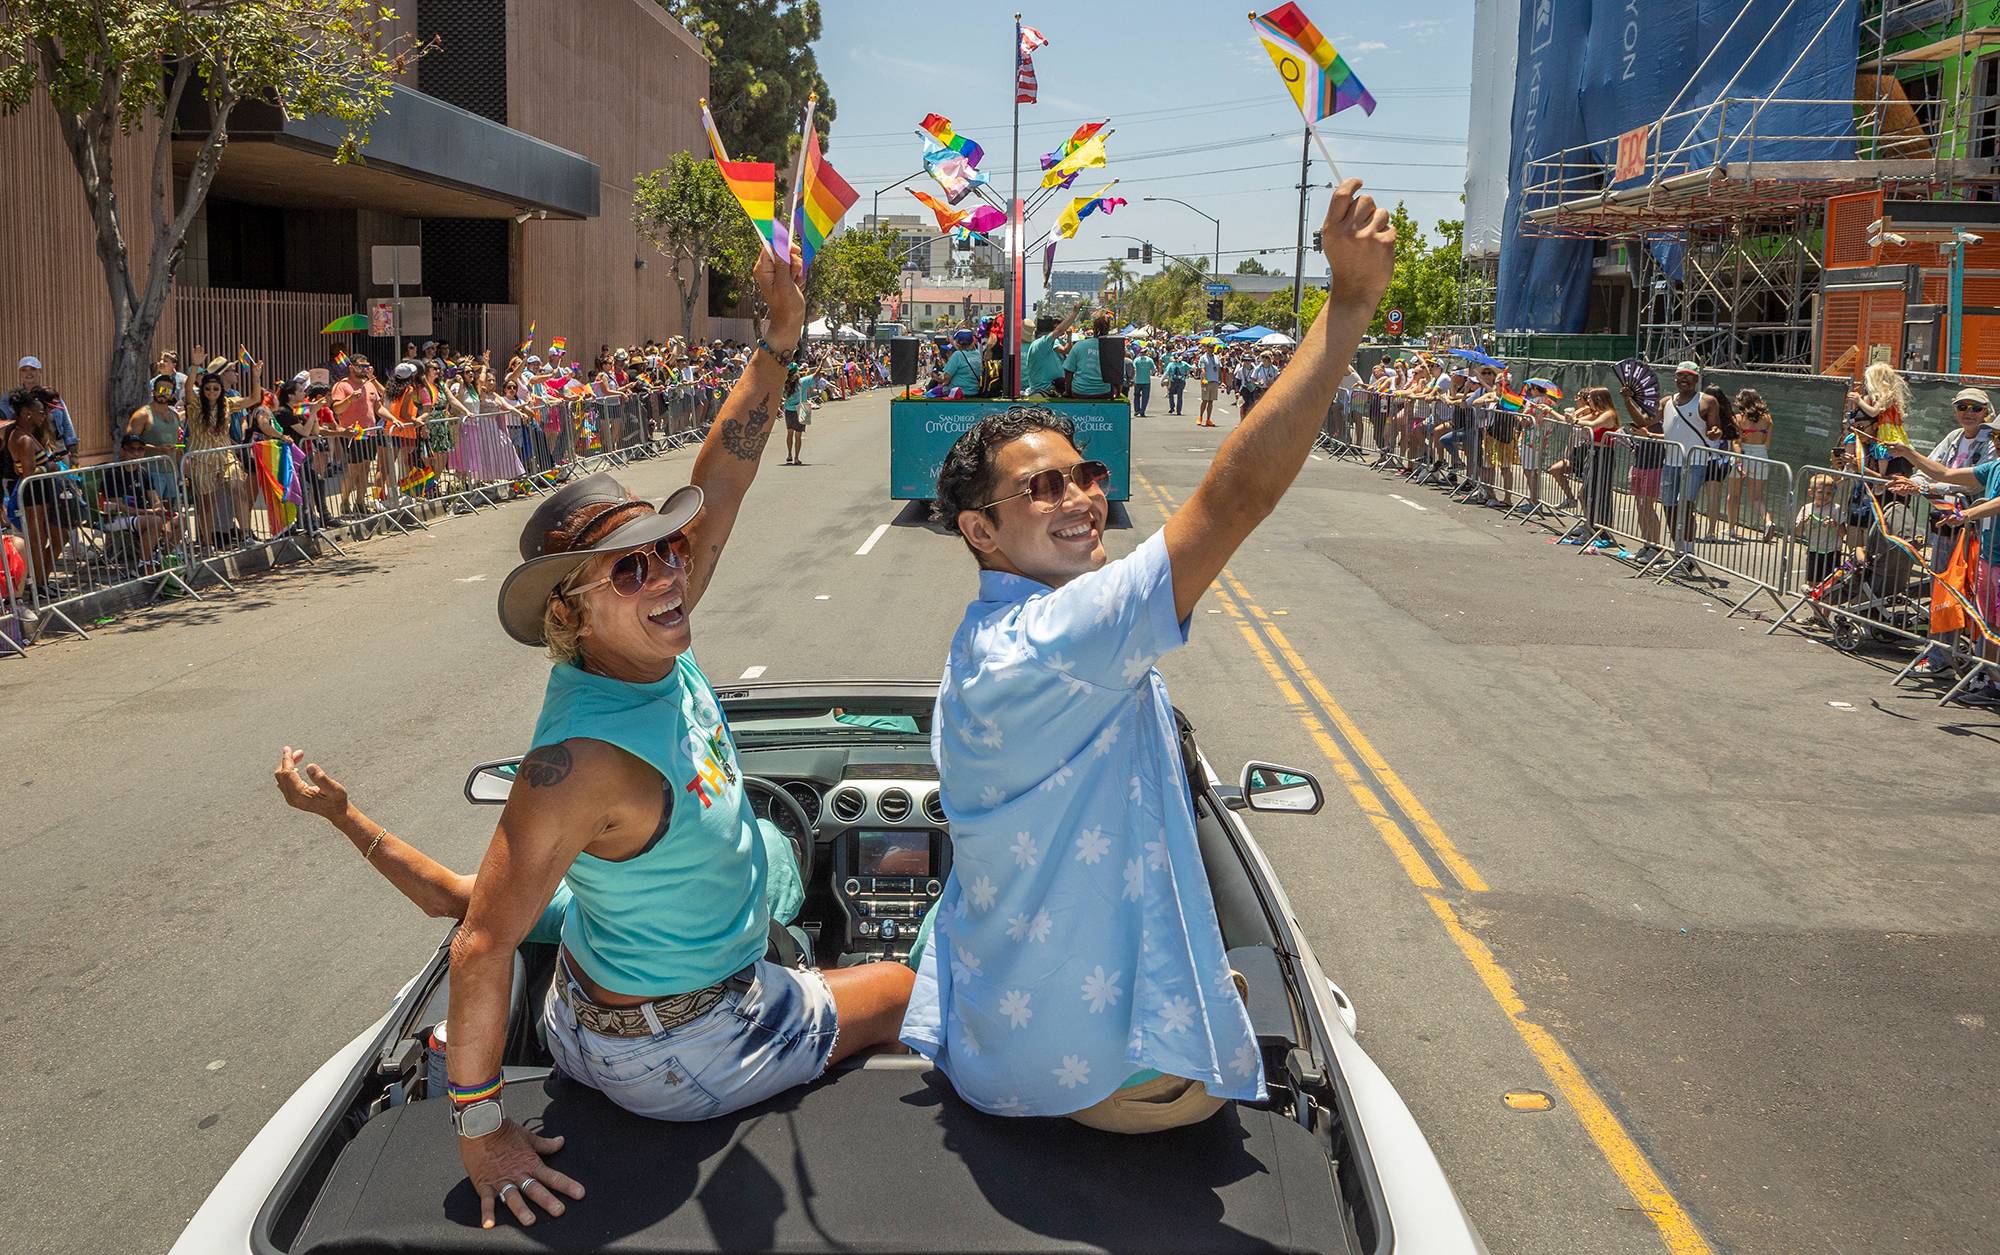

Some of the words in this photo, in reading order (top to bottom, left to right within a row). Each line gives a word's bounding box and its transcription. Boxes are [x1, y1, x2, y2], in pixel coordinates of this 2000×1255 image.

[1522, 62, 1541, 187] KENY
[1391, 312, 1399, 320] P
[944, 421, 977, 433] COLLE
